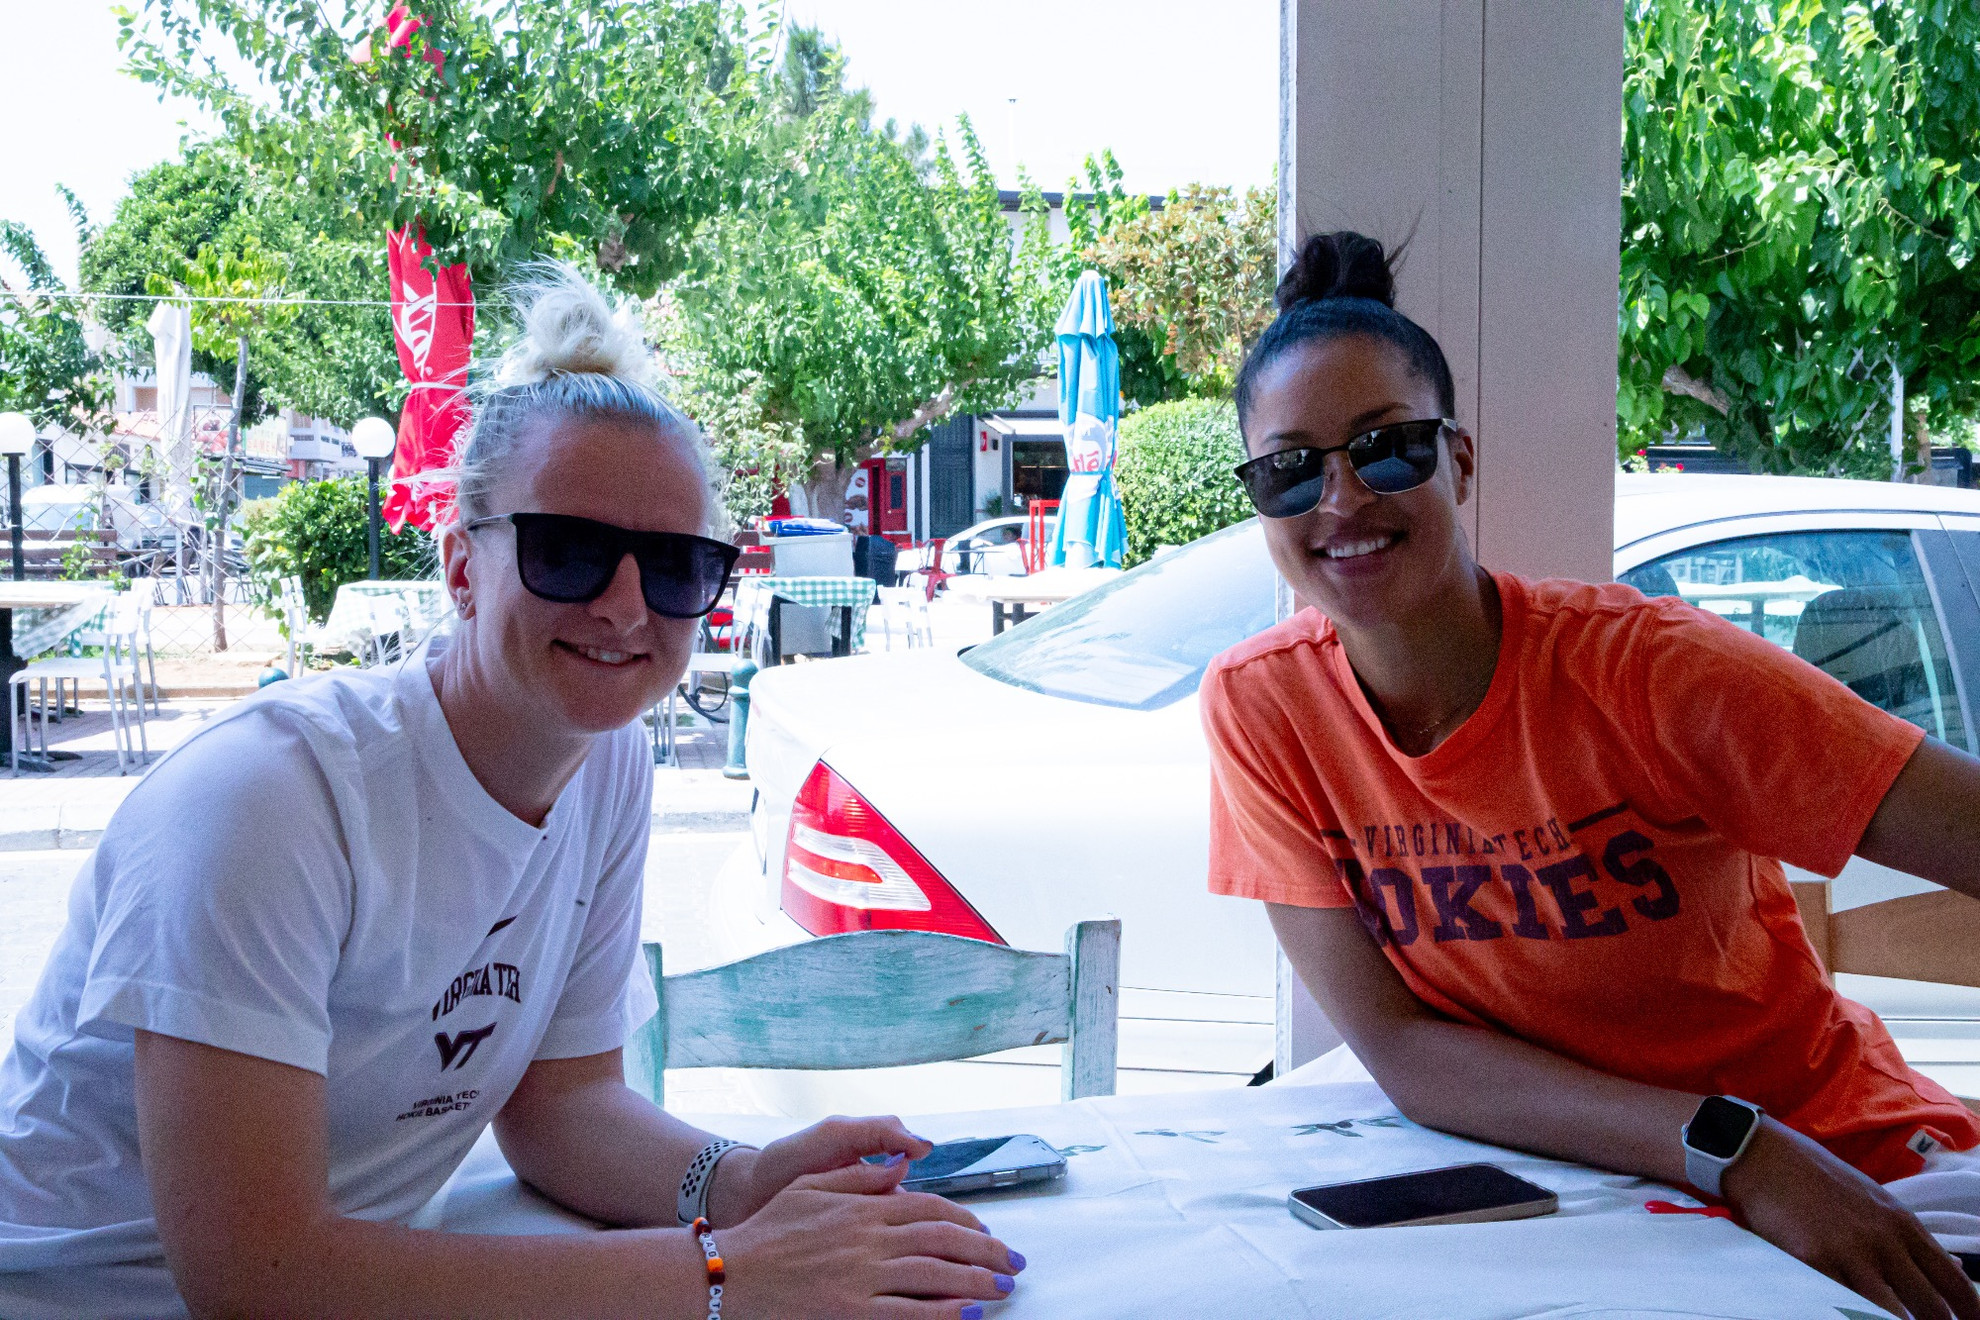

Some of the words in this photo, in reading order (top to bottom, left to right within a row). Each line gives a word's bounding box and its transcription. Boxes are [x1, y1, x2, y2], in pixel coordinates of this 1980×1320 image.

[1493, 817, 1571, 861] TECH
[1335, 829, 1680, 947] OKIES
[434, 1022, 498, 1072] VT
[425, 1102, 471, 1117] BASKET
[456, 1090, 479, 1100] TEC
